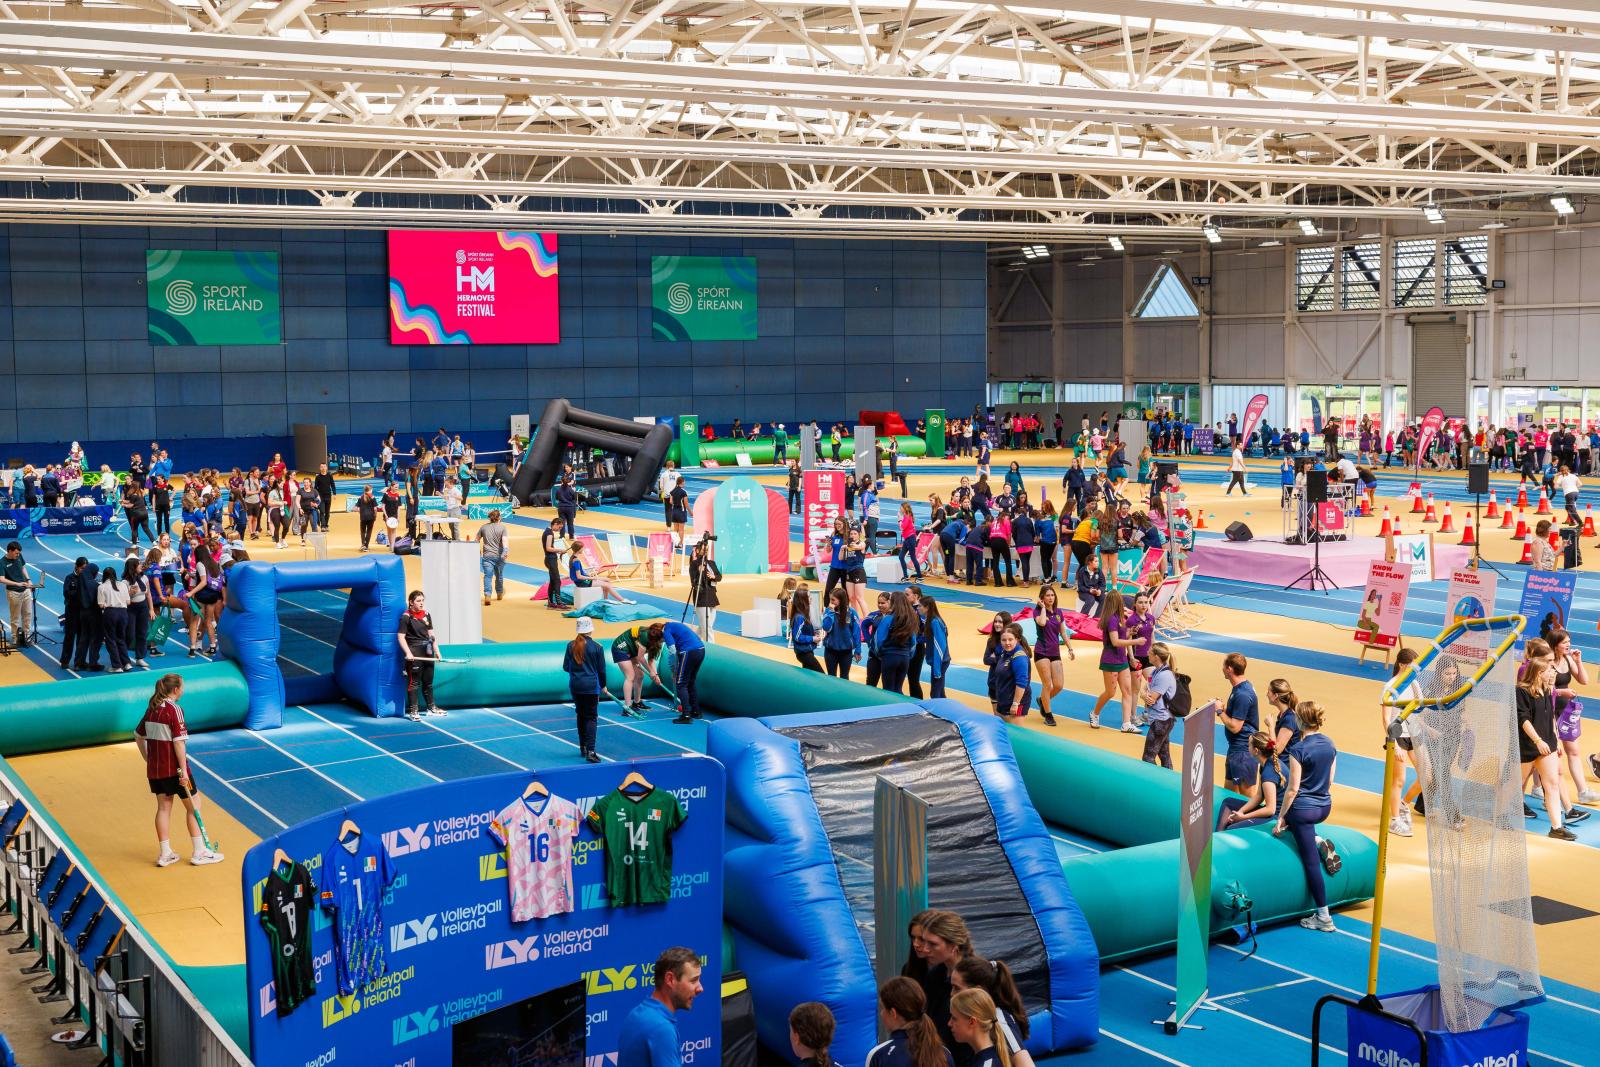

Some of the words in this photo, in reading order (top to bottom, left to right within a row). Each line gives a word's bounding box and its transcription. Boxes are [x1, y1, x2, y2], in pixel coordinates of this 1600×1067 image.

[456, 266, 494, 292] HM
[202, 286, 247, 298] SPORT
[697, 285, 730, 298] SPÓRT
[202, 300, 263, 311] IRELAND
[457, 304, 496, 316] FESTIVAL
[697, 298, 743, 310] ÉIREANN
[818, 474, 832, 482] HM
[730, 488, 750, 500] HM
[1399, 542, 1425, 562] HM
[1527, 583, 1571, 593] Gorgeous
[1528, 575, 1559, 586] Bloody
[1190, 794, 1204, 814] HOCKEY
[433, 810, 496, 833] Volleyball
[1190, 806, 1204, 825] IRELAND
[434, 826, 480, 847] Ireland
[624, 822, 648, 851] 14
[528, 832, 560, 863] 16
[353, 878, 362, 910] 1
[441, 899, 502, 924] Volleyball
[441, 916, 486, 938] Ireland
[544, 924, 609, 946] Volleyball
[544, 940, 592, 958] Ireland
[364, 983, 401, 1009] Ireland
[443, 988, 502, 1015] Volleyball
